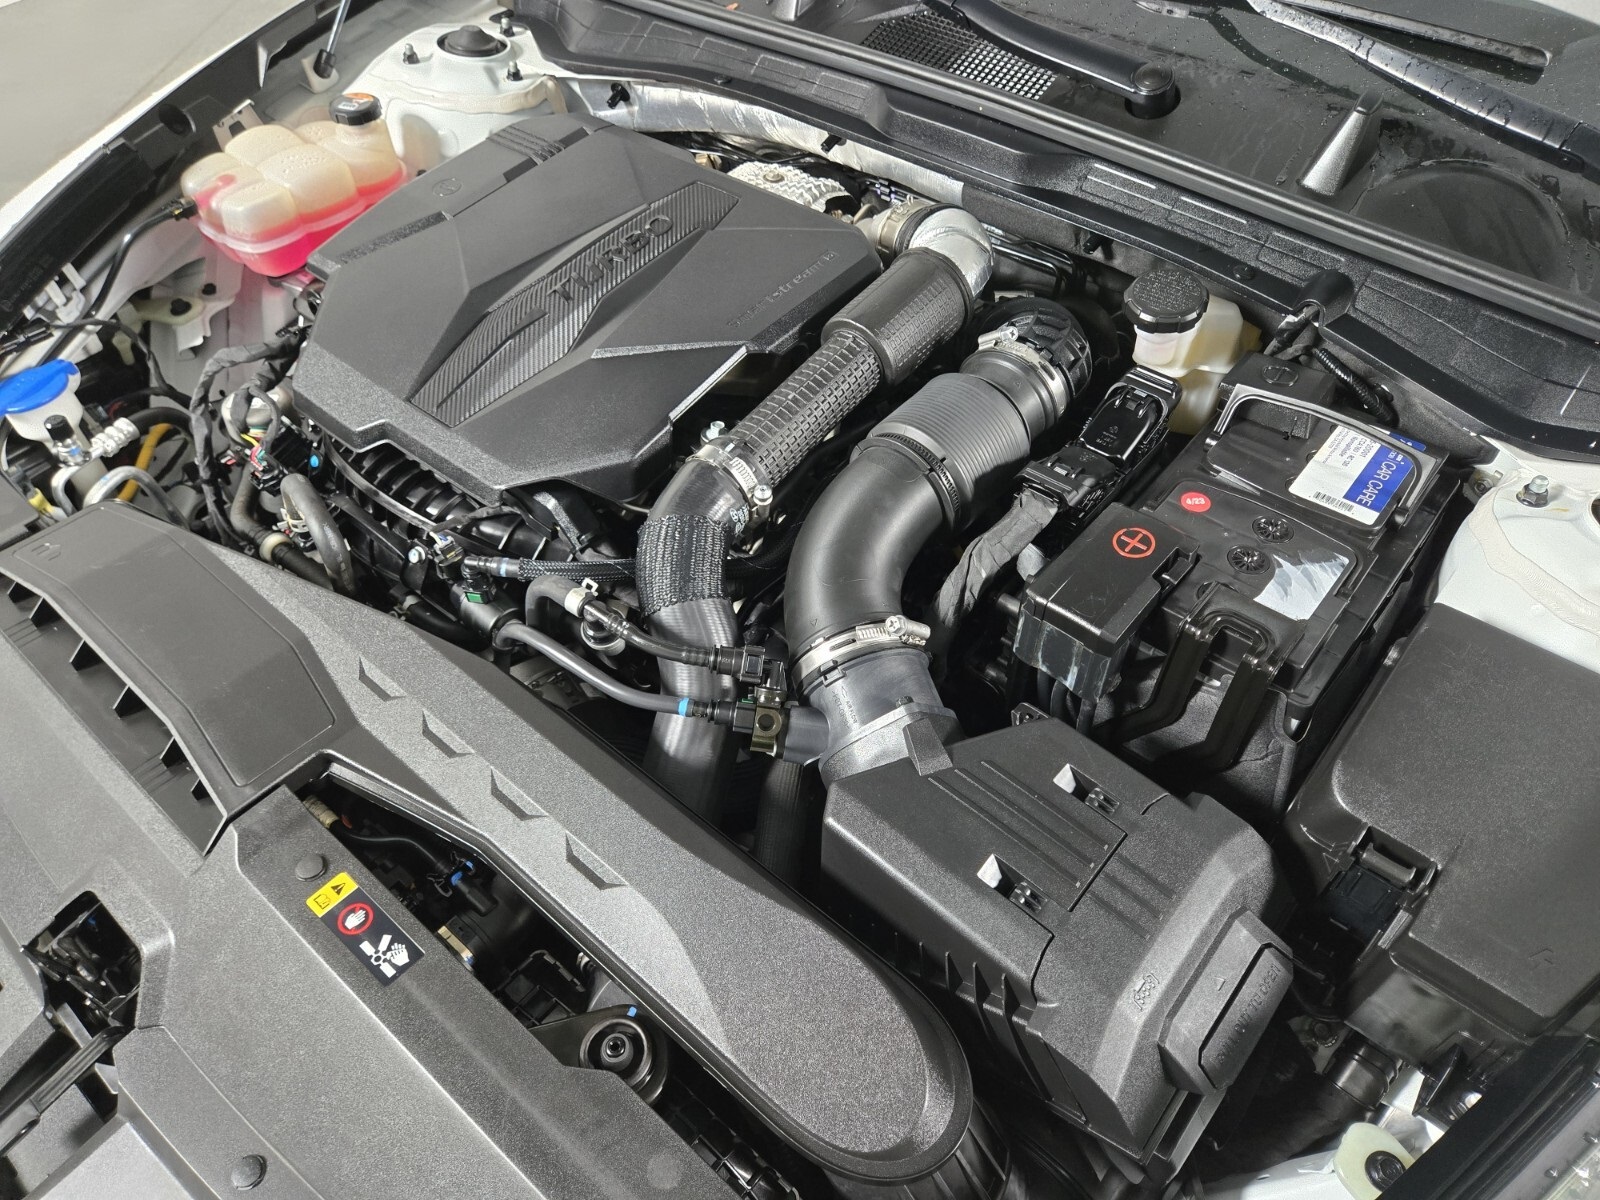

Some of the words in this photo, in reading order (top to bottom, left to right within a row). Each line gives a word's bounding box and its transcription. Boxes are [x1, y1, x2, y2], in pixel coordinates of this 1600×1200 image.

[546, 214, 673, 303] TURBO
[1374, 461, 1397, 481] CAR
[1356, 480, 1383, 507] CARE
